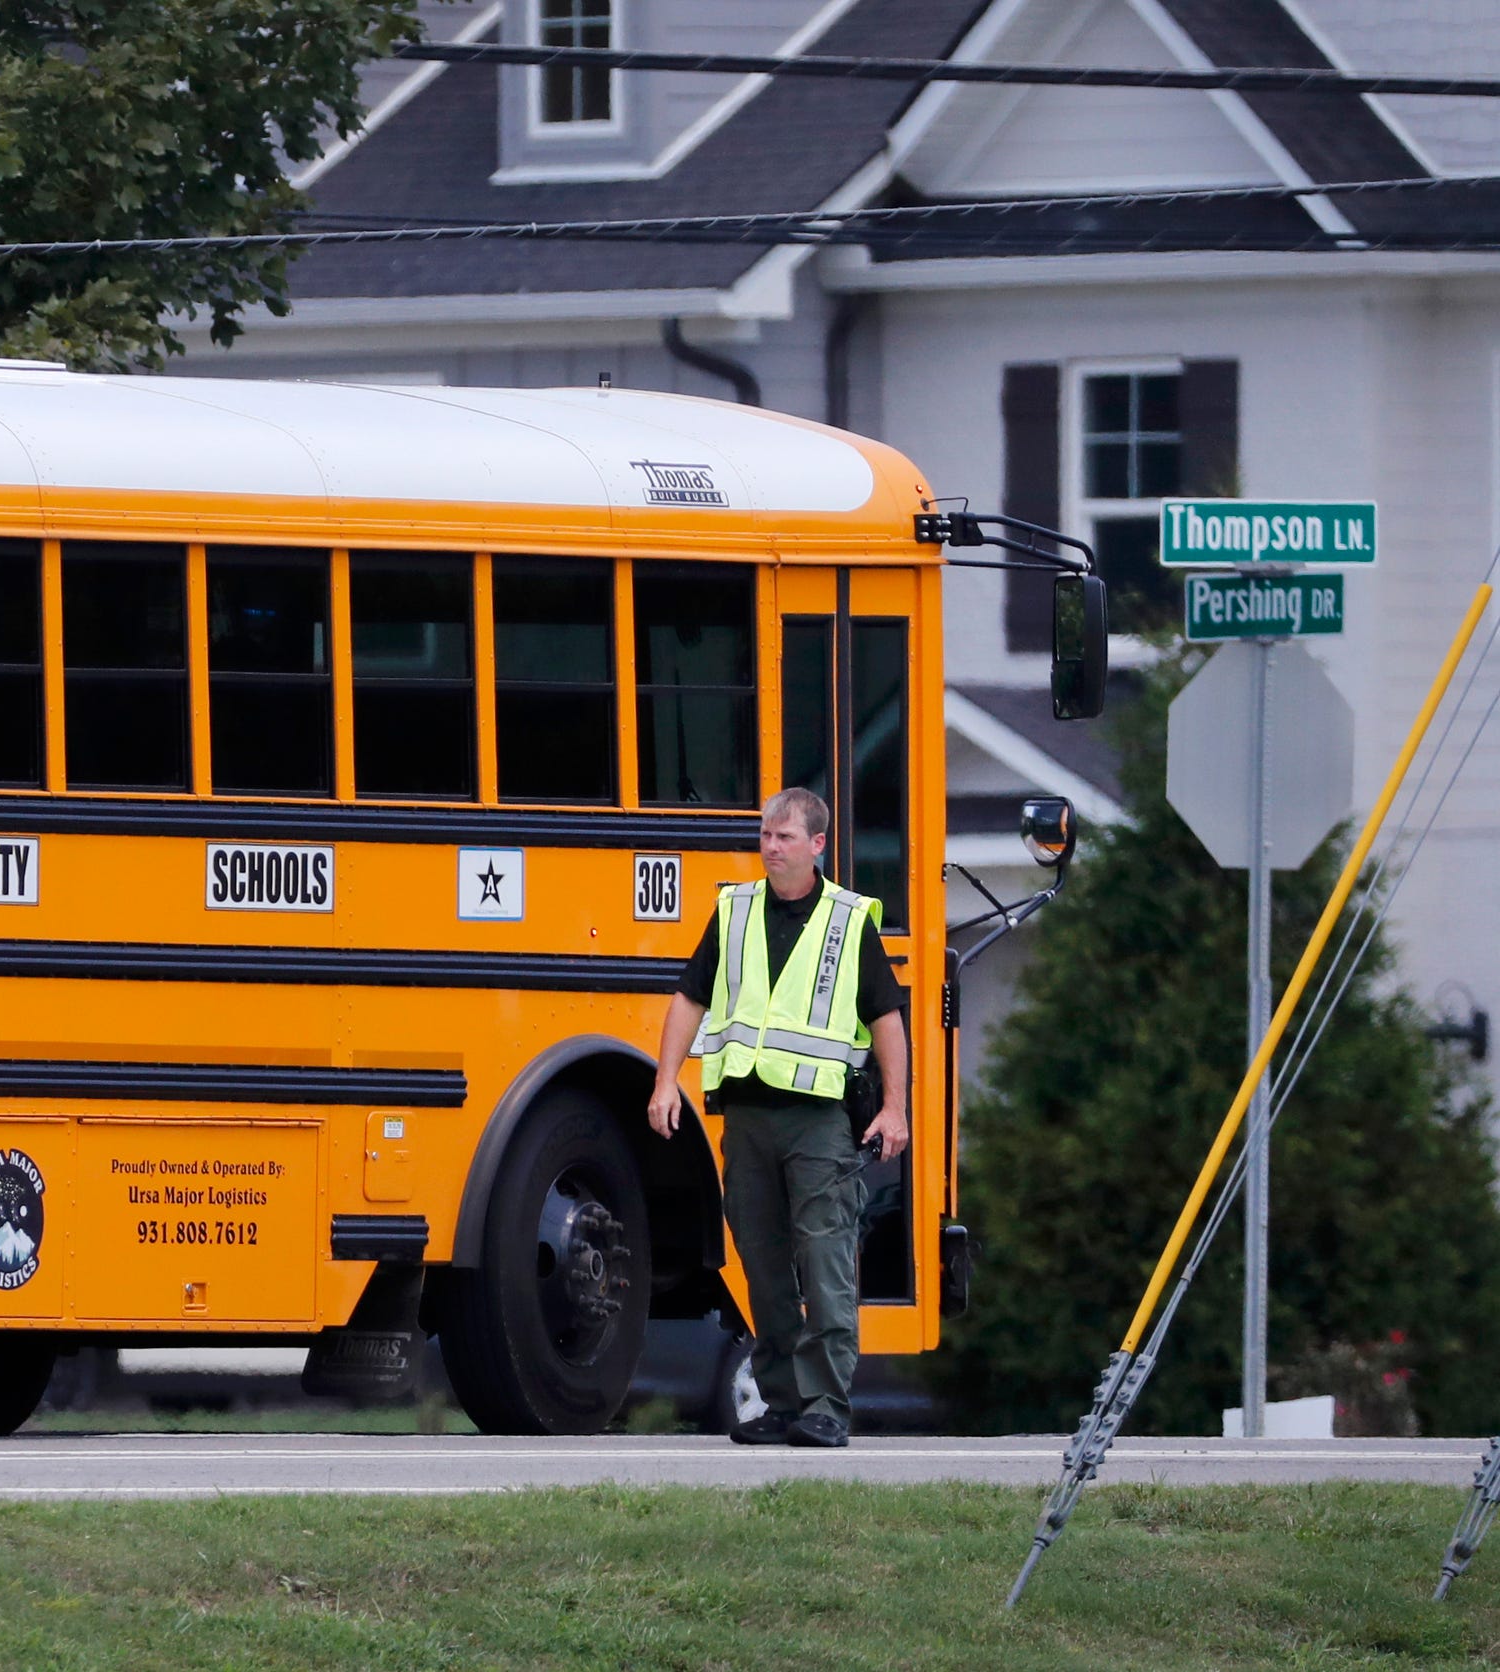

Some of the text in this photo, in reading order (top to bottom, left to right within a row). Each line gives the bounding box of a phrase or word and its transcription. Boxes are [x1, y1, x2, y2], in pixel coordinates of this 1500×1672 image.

[629, 458, 714, 489] Thomas
[651, 490, 720, 503] BUILT BUSES
[1167, 504, 1371, 561] Thompson LN.
[1192, 579, 1342, 633] Pershing DR.
[213, 849, 328, 905] SCHOOLS
[638, 861, 676, 913] 303
[817, 925, 842, 995] SHERIFF
[9, 1151, 43, 1194] MAJOR
[111, 1159, 285, 1179] Proudly Owned & Operated By:
[128, 1186, 267, 1209] Ursa Major Logistics
[137, 1220, 258, 1245] 931.808.7612
